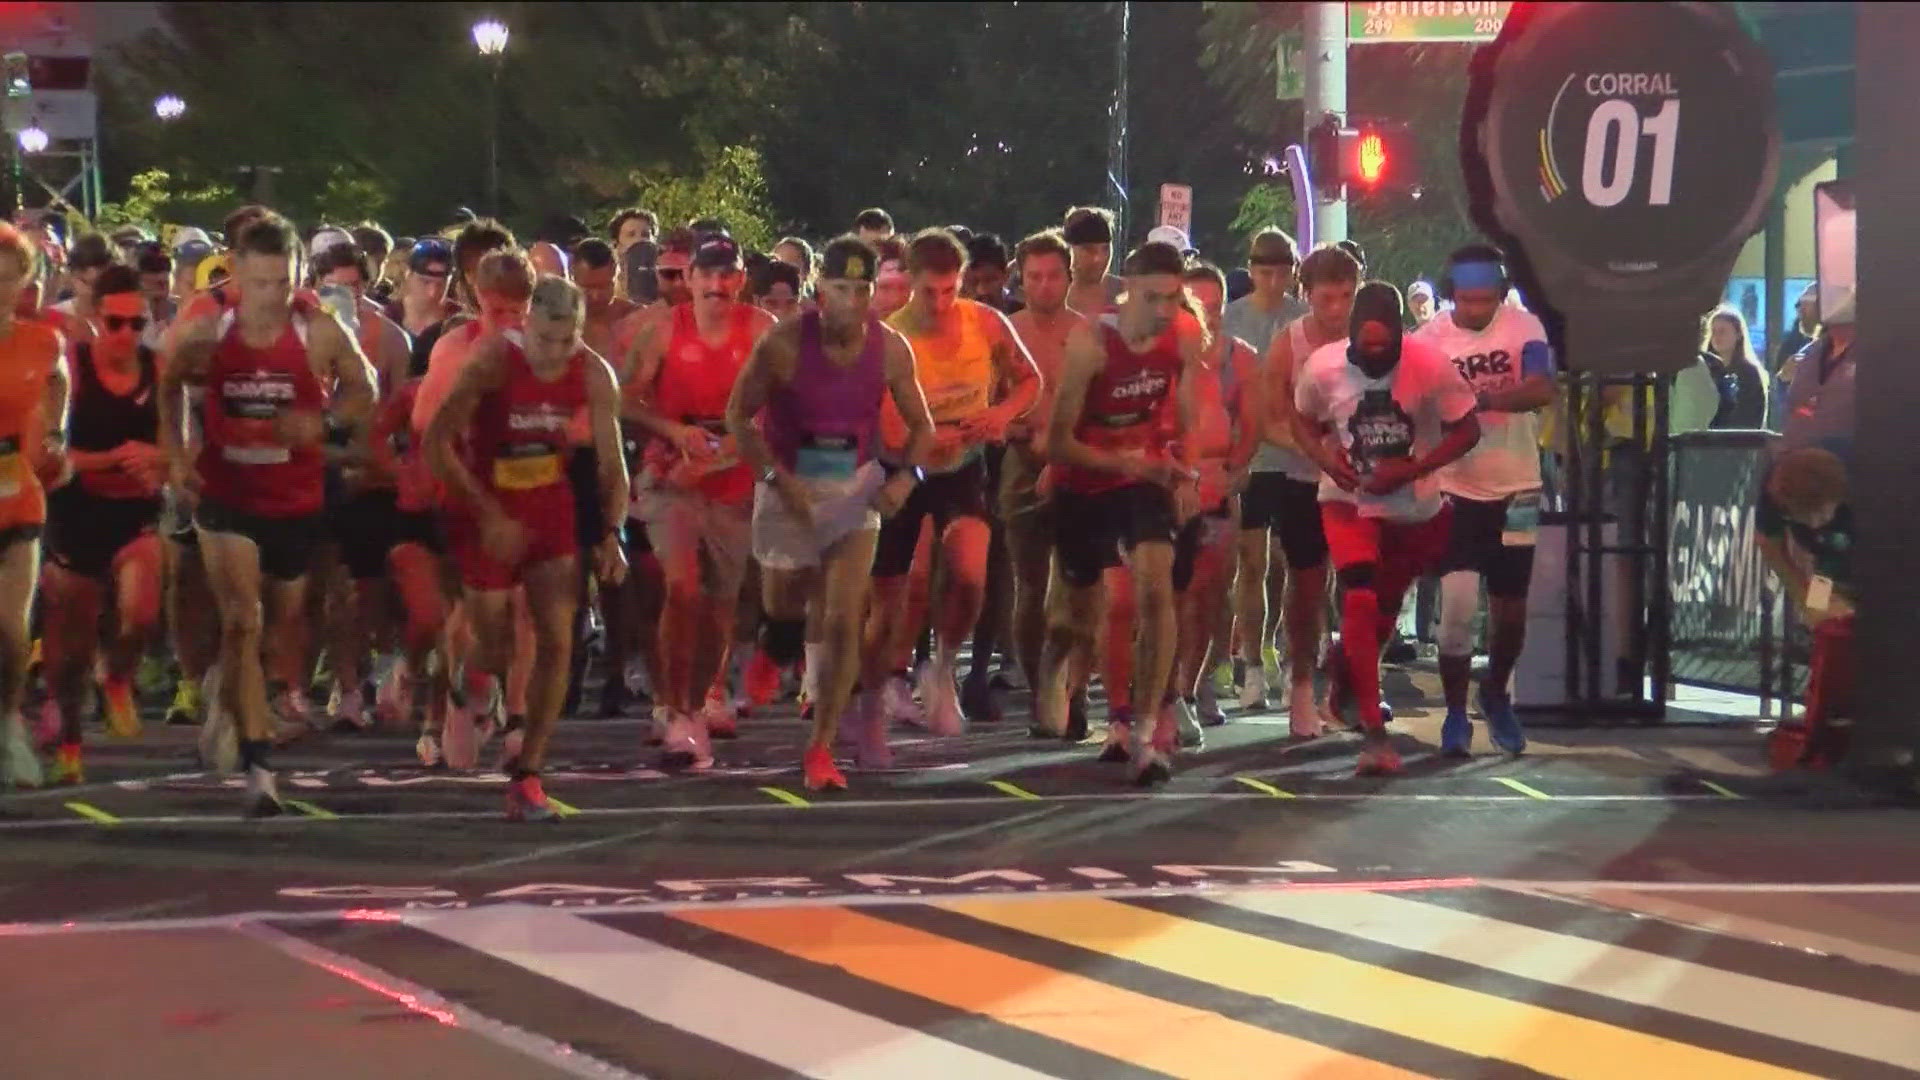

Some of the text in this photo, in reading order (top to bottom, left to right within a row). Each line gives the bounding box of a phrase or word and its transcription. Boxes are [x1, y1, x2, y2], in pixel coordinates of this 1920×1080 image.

[1364, 17, 1503, 34] 299 200
[1585, 72, 1679, 95] CORRAL
[1582, 98, 1681, 207] 01
